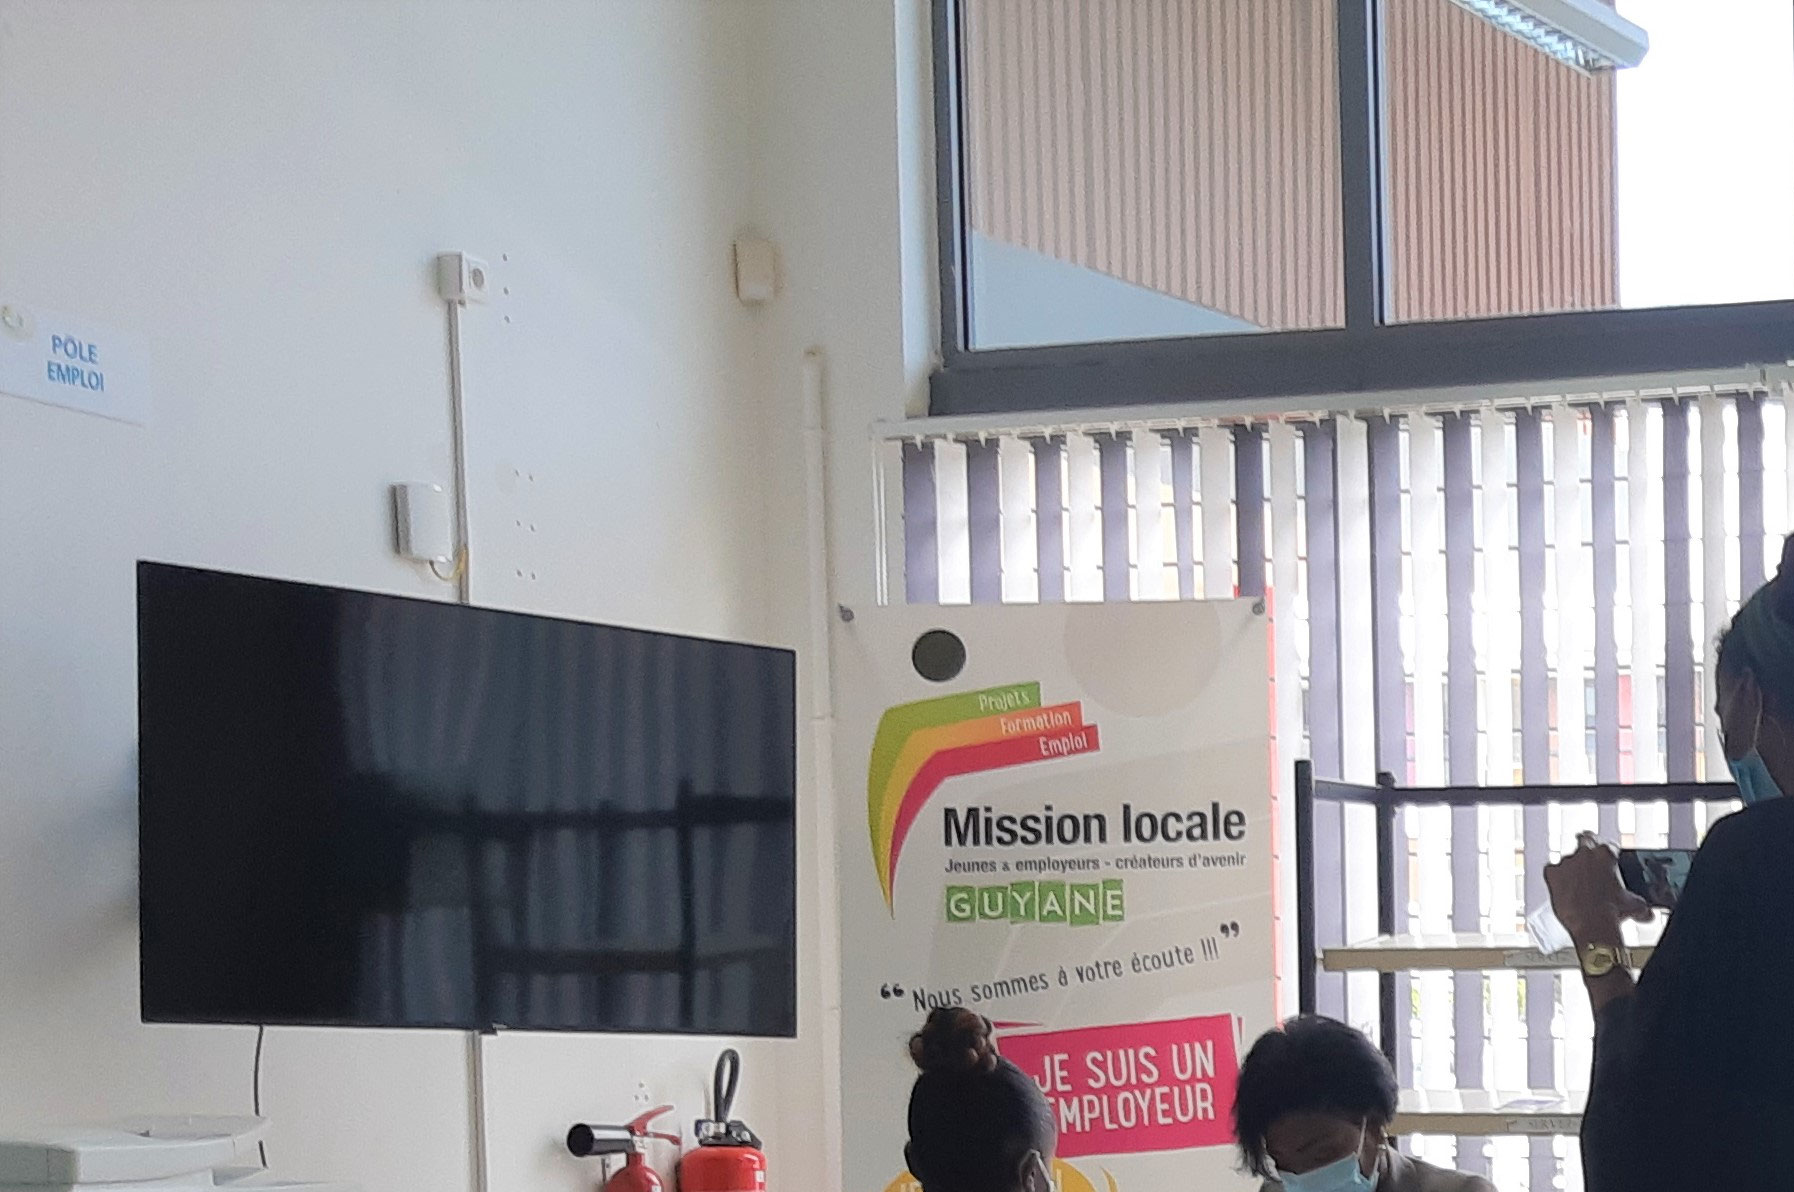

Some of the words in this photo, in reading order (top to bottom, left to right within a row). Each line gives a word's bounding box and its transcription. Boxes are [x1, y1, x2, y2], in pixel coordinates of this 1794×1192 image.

[47, 361, 105, 392] EMPLOI
[978, 690, 1030, 713] Projets
[1000, 710, 1072, 736] Formation
[1039, 731, 1088, 757] Emploi
[943, 804, 1108, 848] Mission
[1122, 801, 1247, 844] locale
[944, 857, 998, 874] Jeunes
[1014, 856, 1101, 874] employeurs
[1114, 853, 1184, 870] créateurs
[1187, 851, 1247, 868] d'avenir
[948, 887, 1125, 919] GUYANE
[913, 987, 963, 1012] Nous
[971, 970, 1049, 1004] sommes
[1058, 965, 1069, 987] à
[1075, 960, 1124, 984] votre
[1130, 945, 1195, 974] écoute
[1033, 1053, 1073, 1093] JE
[1085, 1046, 1159, 1089] SUIS
[1171, 1039, 1215, 1081] UN
